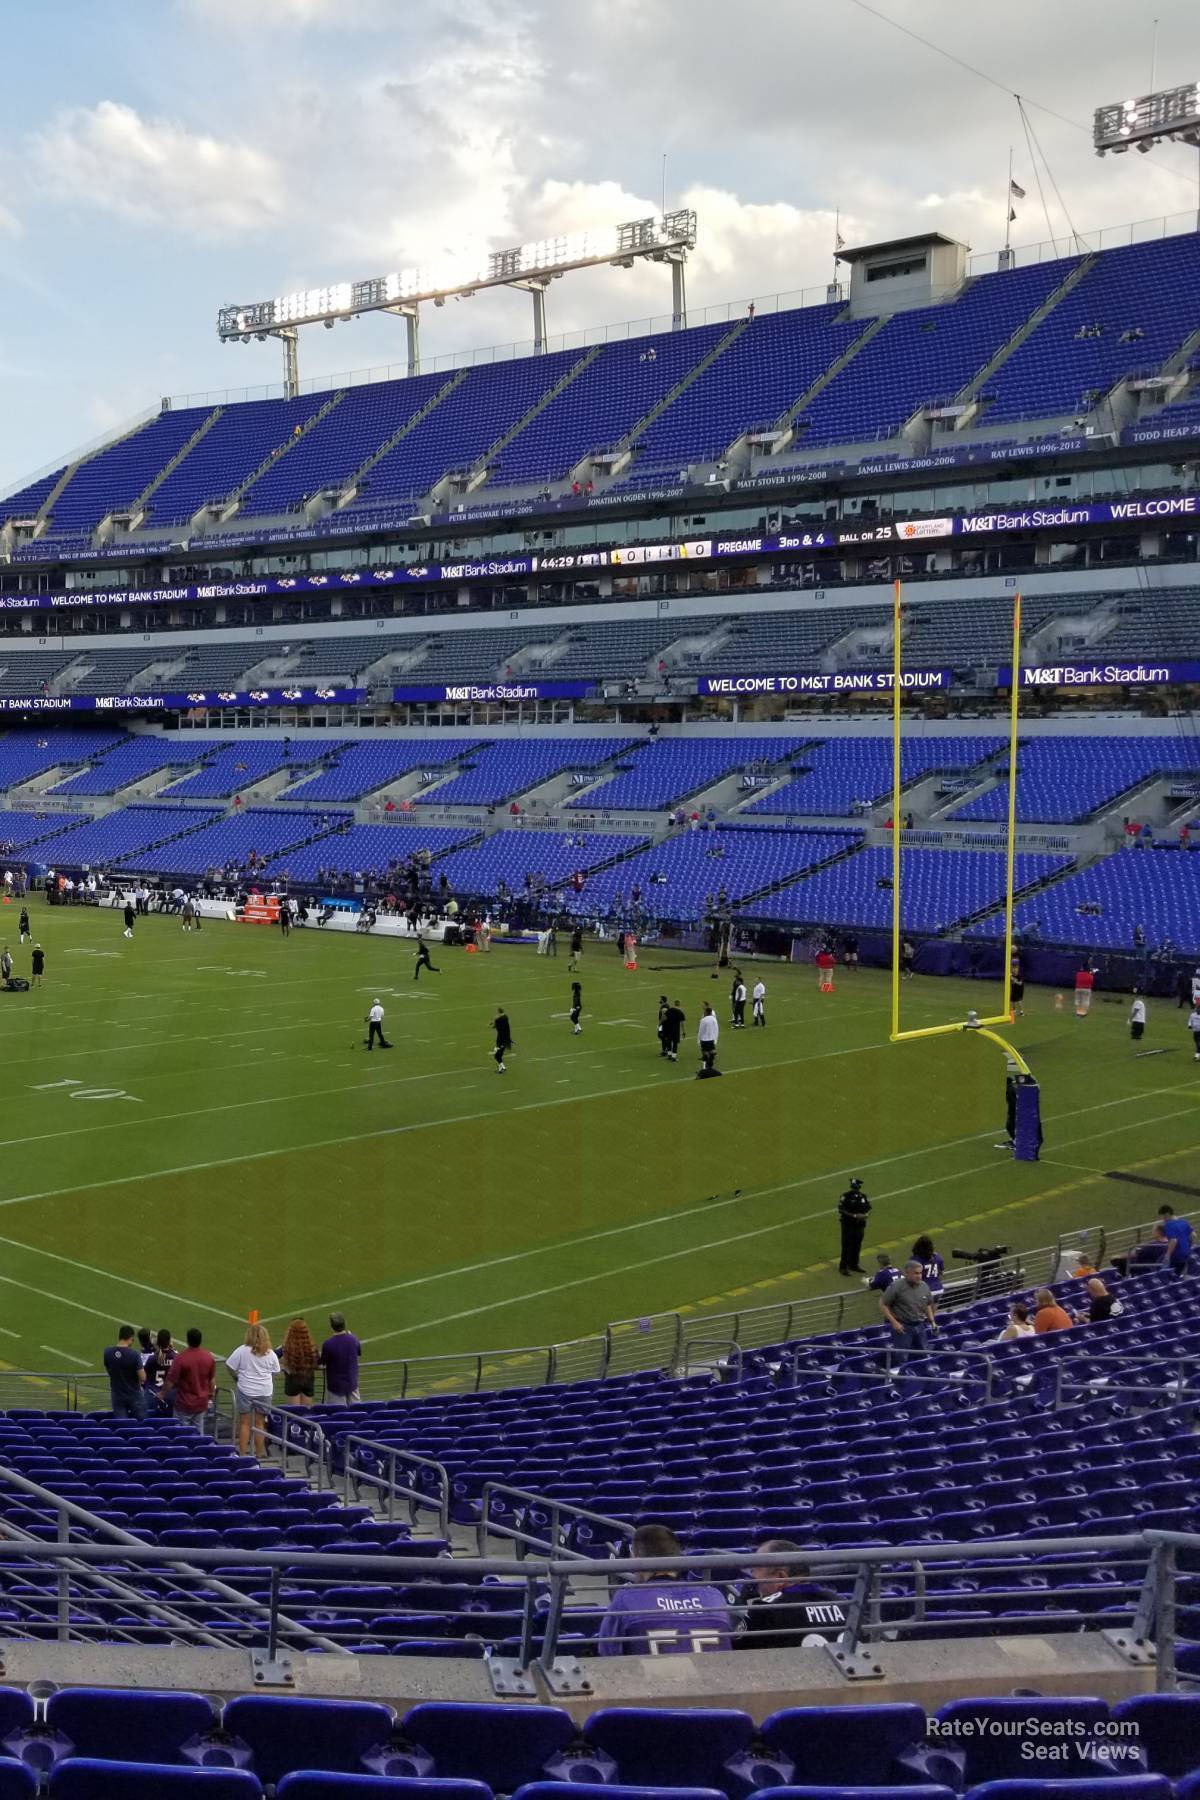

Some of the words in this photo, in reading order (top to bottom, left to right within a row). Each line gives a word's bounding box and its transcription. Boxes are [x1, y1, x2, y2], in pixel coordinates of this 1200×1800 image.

[1134, 431, 1161, 442] TODD
[1163, 426, 1189, 438] HEAP
[991, 450, 1007, 459] RAY
[1008, 446, 1033, 457] LEWIS
[1035, 440, 1081, 455] 1996-2012
[856, 464, 884, 476] JAMAL
[885, 461, 909, 472] LEWIS
[911, 455, 955, 469] 2000-2006
[737, 478, 756, 489] MATT
[758, 476, 785, 487] STOVER
[588, 494, 622, 507] JONATHAN
[623, 492, 646, 502] OGDEN
[648, 488, 684, 500] 1996-2007
[1110, 498, 1196, 518] WELCOME
[449, 514, 466, 522] PETER
[961, 516, 997, 533] M&T
[998, 512, 1031, 530] Bank
[1032, 509, 1089, 528] Stadium
[330, 526, 353, 535] MICHAEL
[839, 534, 858, 543] BALL
[875, 527, 892, 539] 25
[718, 540, 762, 554] PREGAME
[778, 537, 799, 548] 3RD
[802, 535, 812, 546] &
[816, 534, 824, 545] 4
[441, 565, 464, 579] M&T
[465, 563, 488, 576] Bank
[488, 560, 526, 575] Stadium
[541, 557, 574, 569] 44:29
[51, 595, 92, 605] WELCOME
[94, 594, 107, 604] TO
[109, 593, 127, 603] M&T
[128, 591, 152, 602] BANK
[153, 589, 188, 601] STADIUM
[197, 586, 217, 598] M&T
[217, 584, 235, 596] Bank
[235, 583, 266, 595] Stadium
[6, 598, 39, 608] Stadium
[708, 677, 775, 692] WELCOME
[778, 677, 798, 690] TO
[801, 676, 831, 689] M&T
[834, 675, 873, 688] BANK
[876, 672, 942, 687] STADIUM
[1024, 668, 1064, 684] M&T
[1064, 668, 1102, 683] Bank
[1104, 665, 1169, 683] Stadium
[446, 686, 471, 699] M&T
[471, 686, 494, 699] Bank
[496, 685, 537, 698] Stadium
[9, 699, 32, 709] BANK
[34, 699, 71, 709] STADIUM
[96, 697, 114, 707] M&T
[114, 697, 132, 707] Bank
[133, 696, 163, 707] Stadium
[24, 1079, 127, 1099] 10
[924, 1263, 938, 1278] 74
[155, 1370, 165, 1386] 5
[657, 1597, 703, 1615] SUGGS
[805, 1605, 845, 1623] PITTA
